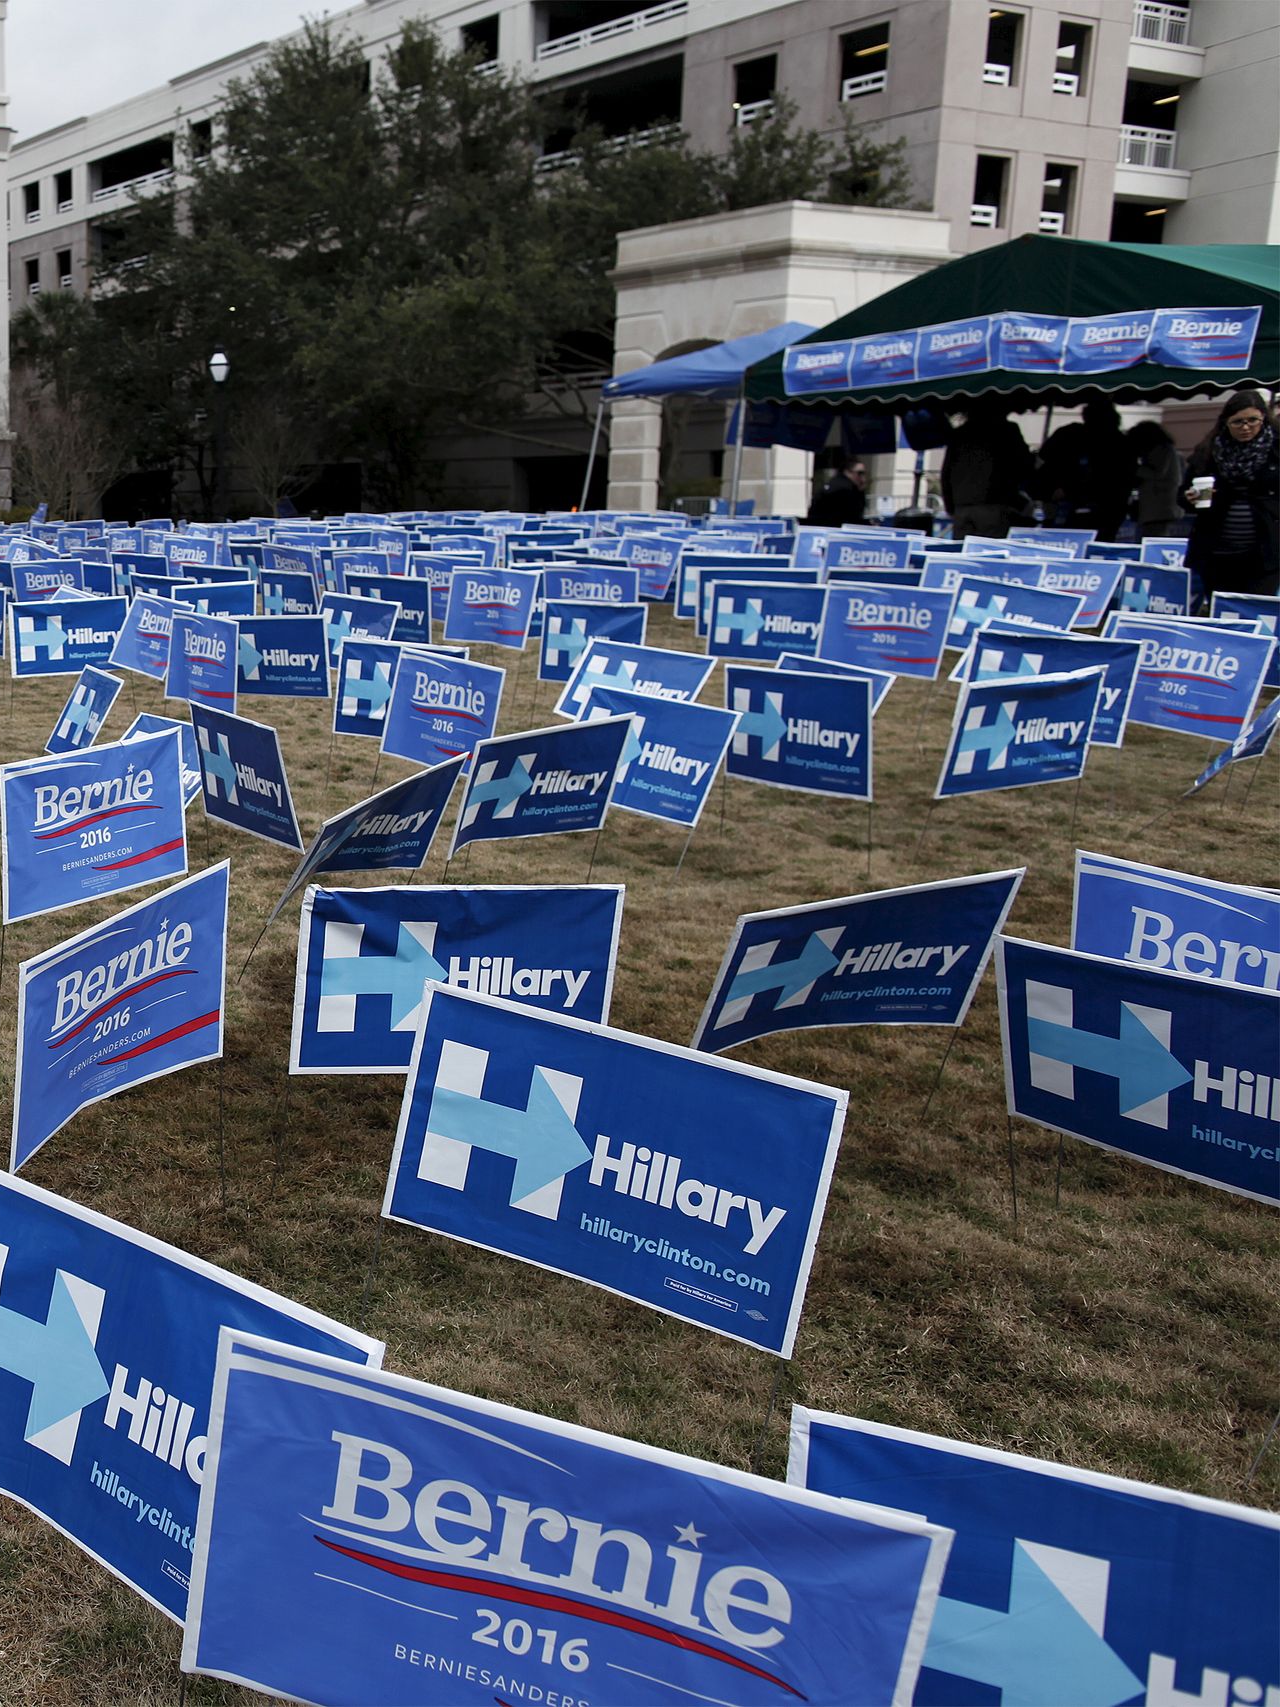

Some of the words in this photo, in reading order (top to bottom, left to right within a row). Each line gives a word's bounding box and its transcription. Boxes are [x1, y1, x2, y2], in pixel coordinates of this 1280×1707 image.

[929, 328, 983, 350] Bernie
[1000, 321, 1058, 343] Bernie
[1082, 321, 1149, 344] Bernie
[1168, 318, 1242, 336] Bernie
[796, 351, 845, 370] Bernie
[864, 340, 913, 361] Bernie
[632, 545, 673, 566] Bernie
[839, 546, 897, 568] Bernie
[25, 570, 75, 589] Bernie
[560, 578, 623, 601] Bernie
[465, 580, 521, 606] Bernie
[846, 598, 932, 629] Bernie
[68, 628, 120, 651] Hillary
[764, 614, 821, 640] Hillary
[872, 633, 898, 645] 2016
[263, 649, 320, 672] Hillary
[1138, 638, 1239, 681] Bernie
[412, 671, 485, 717] Bernie
[1158, 680, 1188, 696] 2016
[432, 718, 453, 734] 2016
[787, 717, 861, 758] Hillary
[1014, 718, 1085, 745] Hillary
[638, 741, 710, 786] Hillary
[785, 755, 860, 775] hillaryclinton.com
[1012, 751, 1077, 768] hillaryclinton.com
[34, 763, 155, 827] Bernie
[236, 762, 283, 807] Hillary
[530, 769, 608, 796] Hillary
[630, 777, 698, 802] hillaryclinton.com
[522, 801, 598, 817] hillaryclinton.com
[352, 808, 434, 839] Hillary
[80, 826, 111, 849] 2016
[62, 846, 133, 872] BERNIESANDERS.COM
[834, 941, 970, 977] Hillary
[51, 917, 193, 1036] Bernie
[449, 956, 591, 1008] Hillary
[821, 983, 952, 1003] hillaryclinton.com
[92, 1006, 131, 1043] 2016
[68, 1026, 152, 1080] BERNIESANDERS.COM
[588, 1133, 787, 1255] Hillary
[579, 1212, 771, 1297] hillaryclinton.com
[321, 1430, 792, 1650] Bernie
[472, 1608, 590, 1673] 2016
